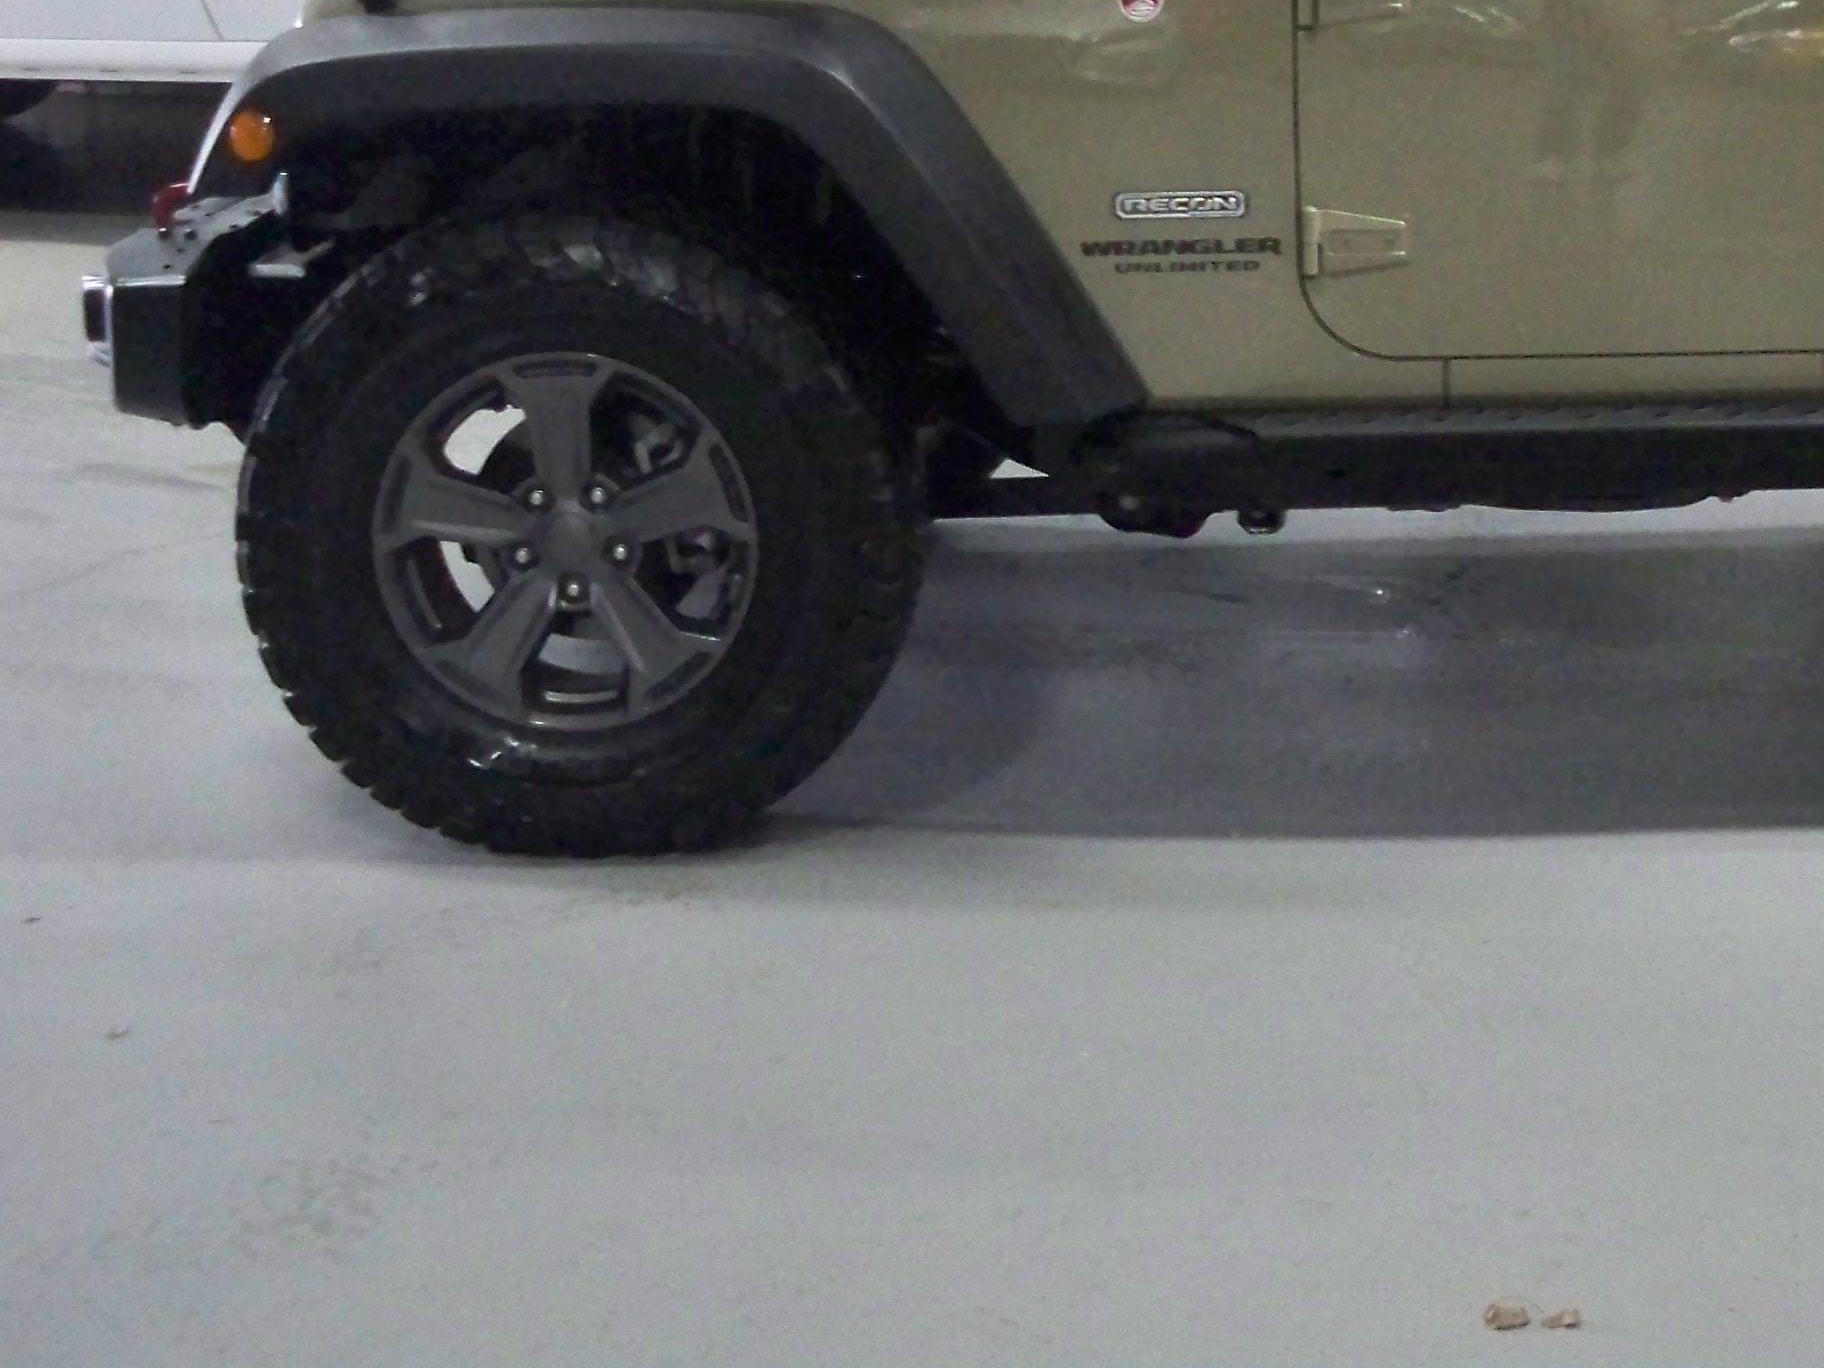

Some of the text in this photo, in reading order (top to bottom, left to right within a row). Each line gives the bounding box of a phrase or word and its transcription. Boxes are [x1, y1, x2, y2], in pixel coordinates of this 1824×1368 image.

[1122, 195, 1239, 214] RECON
[1080, 237, 1283, 257] WRANGLER
[1114, 259, 1261, 274] UNLIMITED
